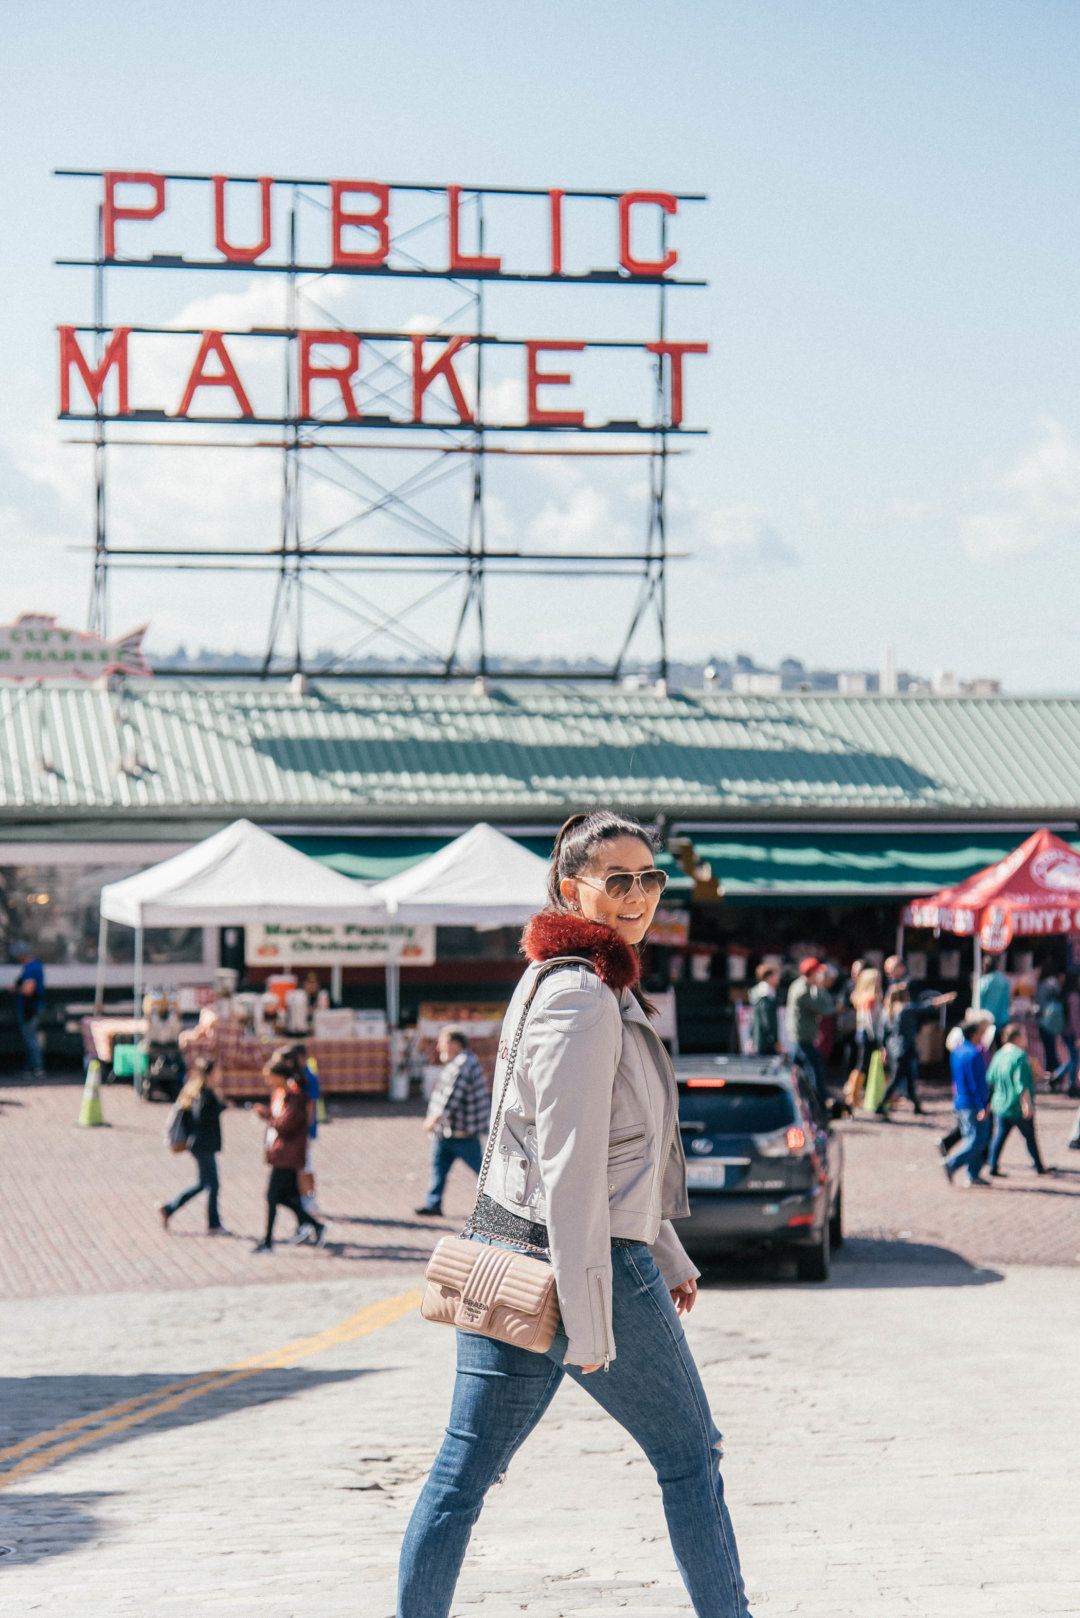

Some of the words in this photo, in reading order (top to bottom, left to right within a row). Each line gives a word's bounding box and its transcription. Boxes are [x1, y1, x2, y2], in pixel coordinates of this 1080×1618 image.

[104, 172, 678, 276] PUBLIC
[58, 325, 708, 428] MARKET
[344, 924, 415, 937] Family
[1012, 910, 1071, 931] TINY'S
[463, 1298, 489, 1311] PRADA
